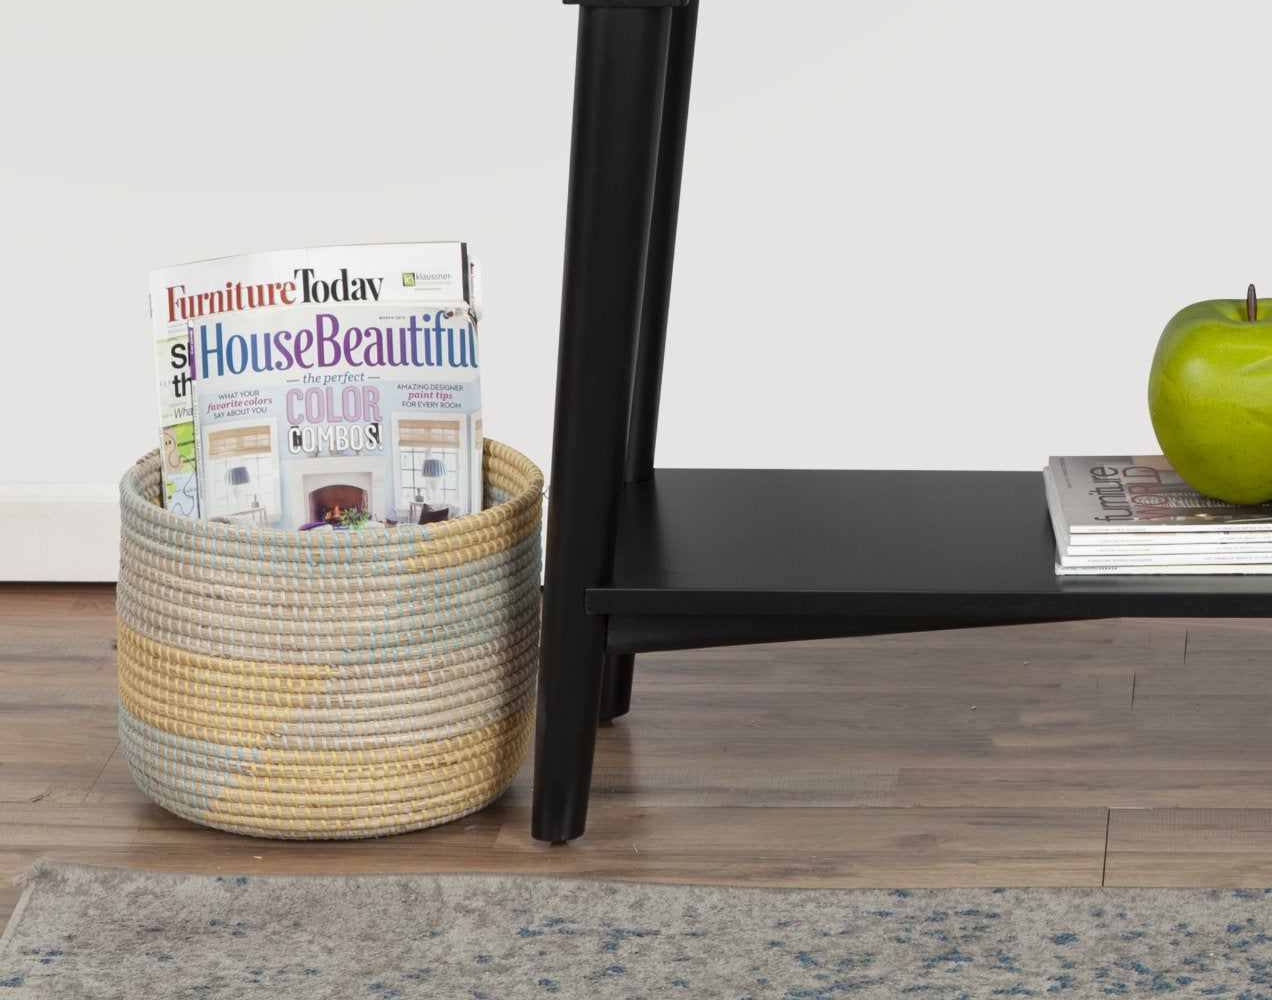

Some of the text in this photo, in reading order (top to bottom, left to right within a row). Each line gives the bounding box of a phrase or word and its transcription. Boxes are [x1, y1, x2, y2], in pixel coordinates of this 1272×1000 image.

[302, 371, 367, 386] the perfect
[217, 389, 261, 401] WHAT YOUR
[396, 383, 465, 392] AMAZING DESIGNER
[407, 390, 454, 402] paint tips
[206, 396, 273, 415] favorite colors
[285, 385, 384, 426] COLOR
[401, 400, 463, 409] FOR EVERY ROOM
[213, 406, 268, 420] SAY ABOUT YOU
[287, 424, 384, 455] COMBOS!
[1088, 465, 1135, 522] furniture
[1121, 465, 1176, 521] WORLD
